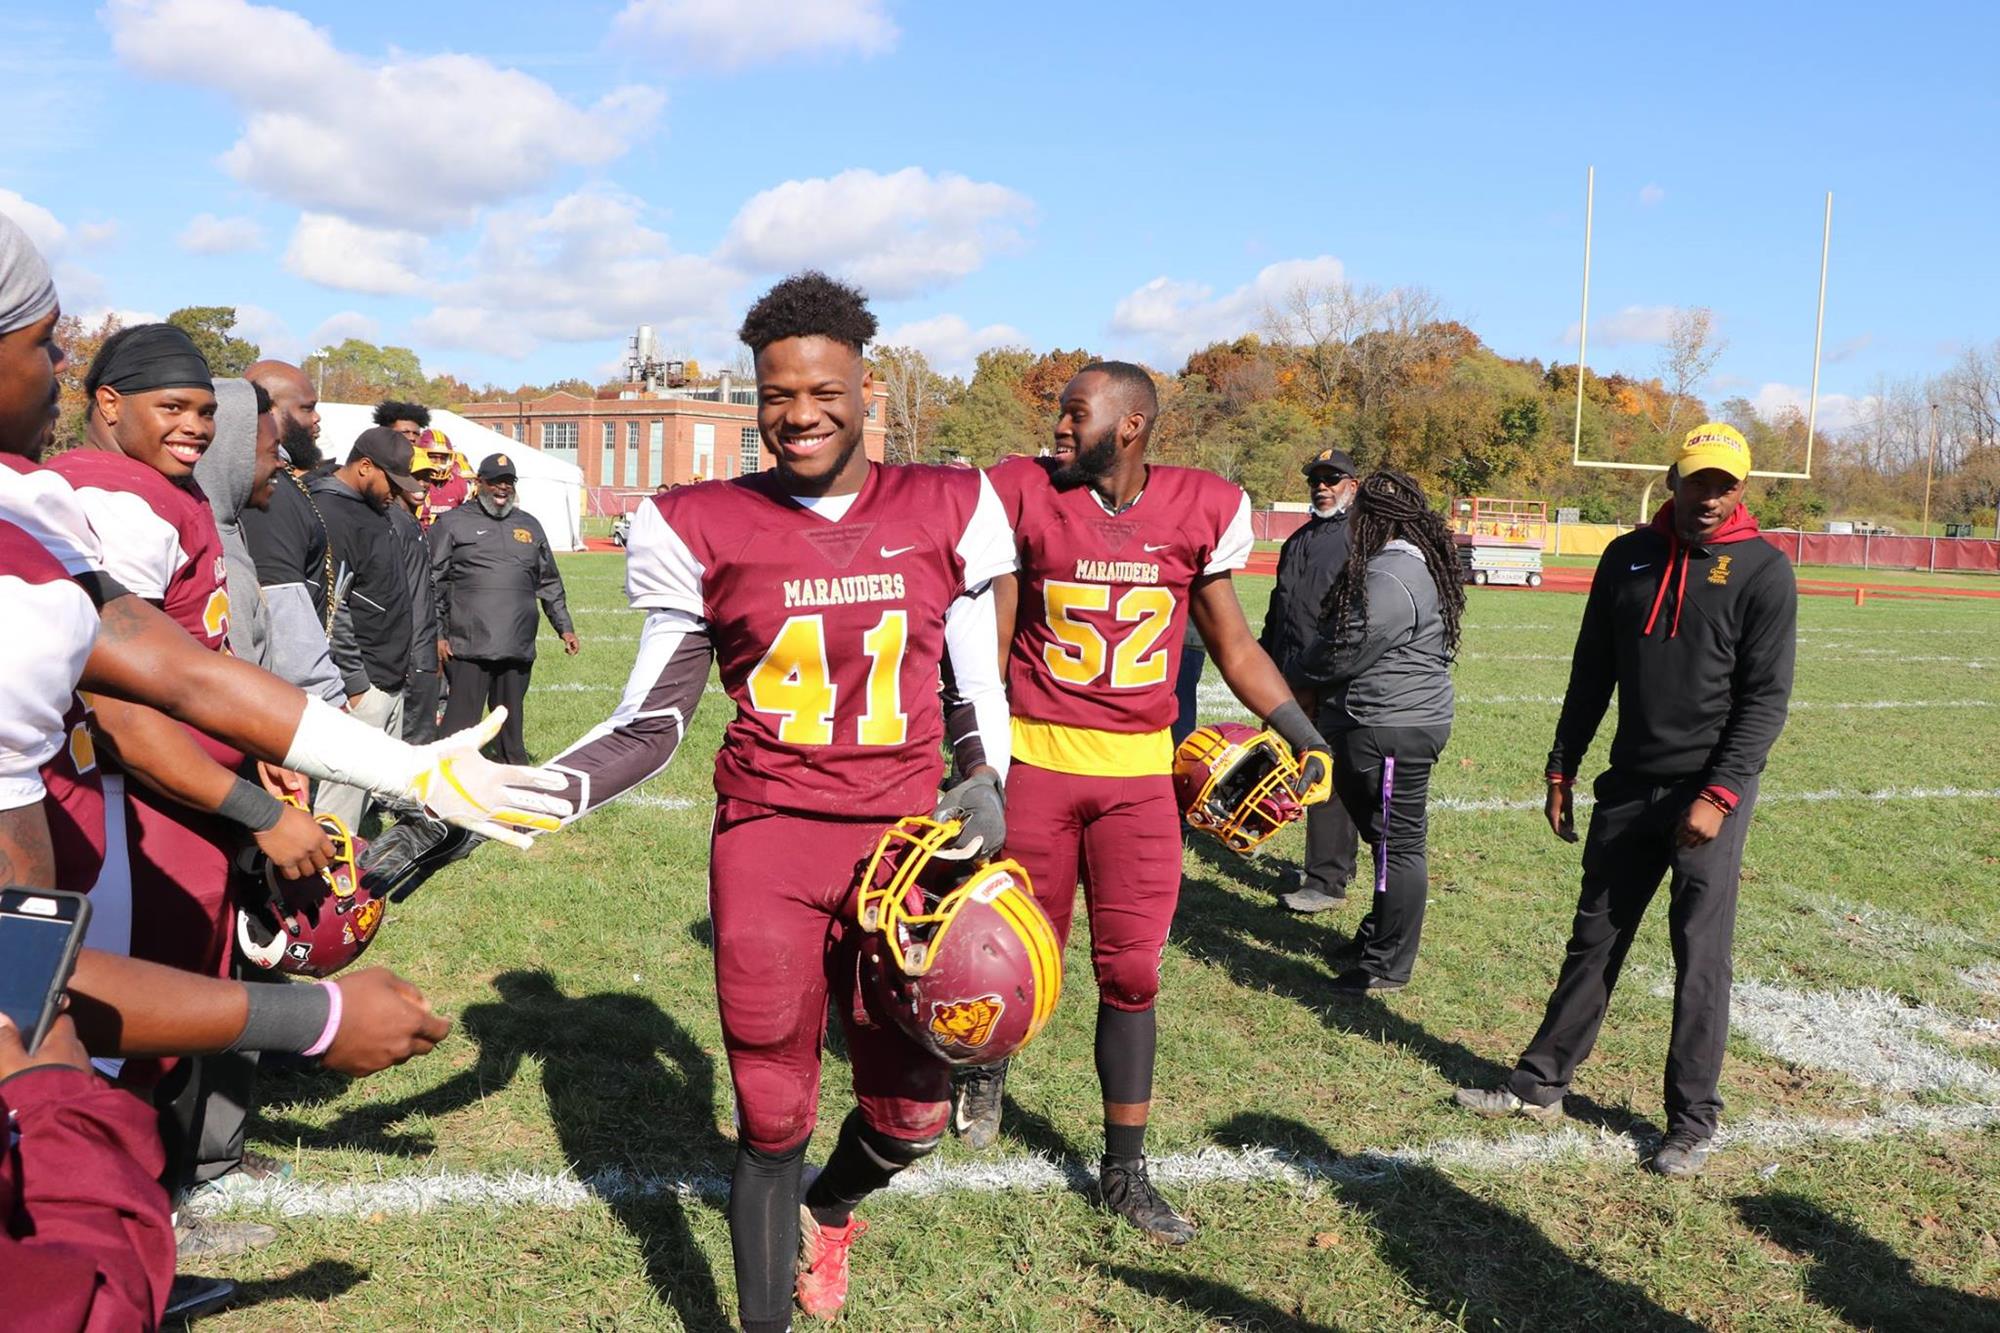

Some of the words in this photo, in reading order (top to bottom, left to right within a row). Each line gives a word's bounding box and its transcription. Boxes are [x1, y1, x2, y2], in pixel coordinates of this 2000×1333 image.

[783, 573, 905, 608] MARAUDERS
[1075, 559, 1159, 584] MARAUDERS
[1043, 579, 1176, 688] 52
[747, 610, 908, 746] 41
